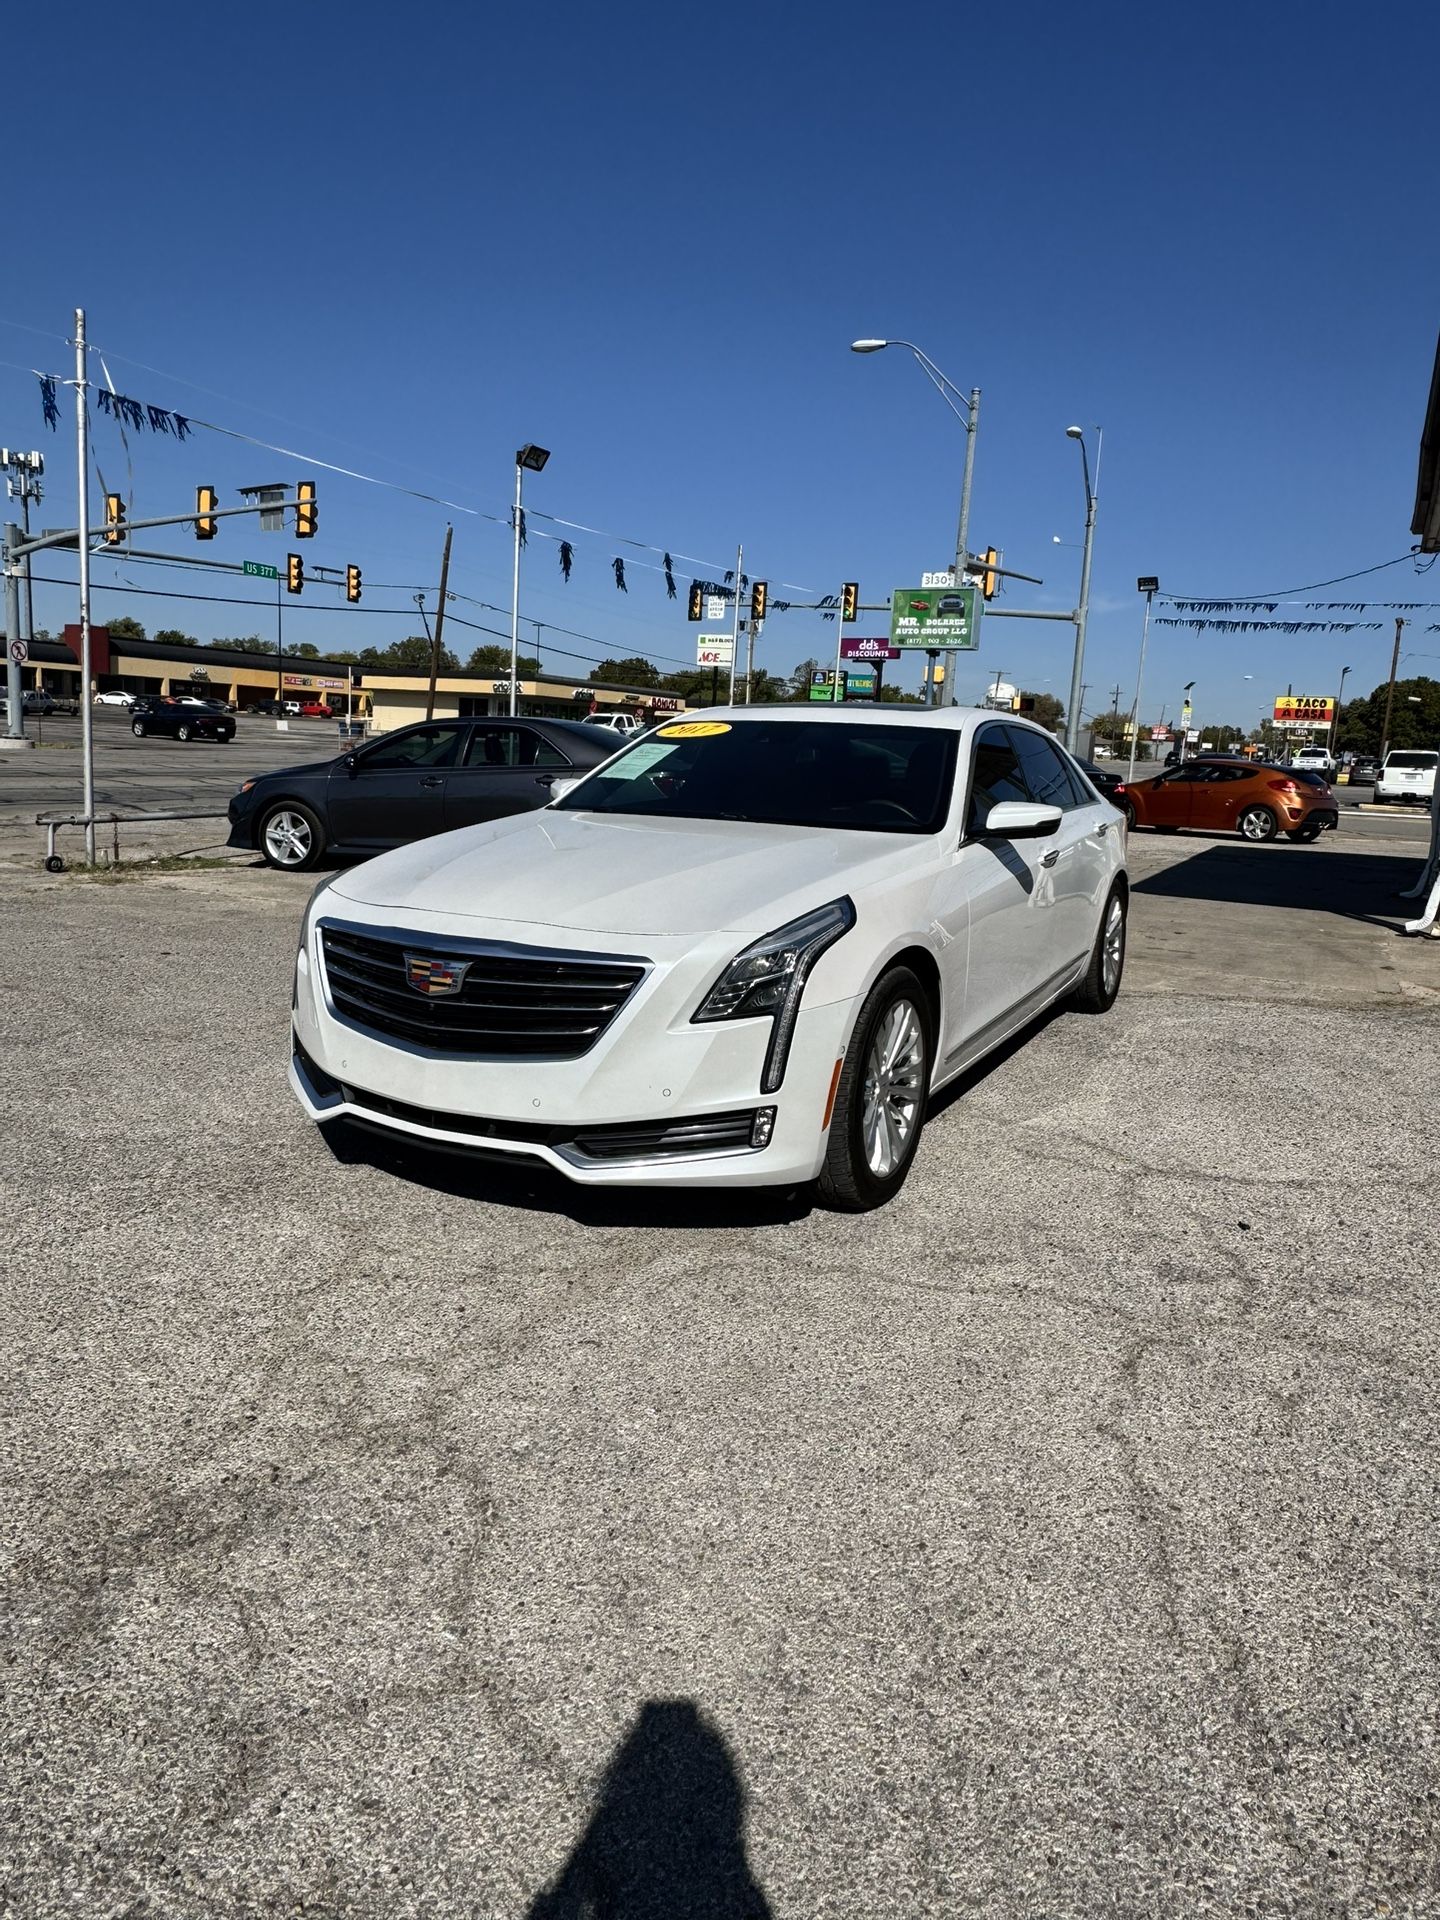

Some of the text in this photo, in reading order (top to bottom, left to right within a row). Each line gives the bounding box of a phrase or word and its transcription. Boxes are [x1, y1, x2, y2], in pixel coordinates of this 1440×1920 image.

[246, 563, 274, 577] US 377
[924, 575, 948, 585] 3130
[898, 617, 920, 626] MR.
[859, 639, 879, 650] dd's
[698, 651, 721, 663] ACE
[1296, 698, 1328, 709] TACO
[1295, 708, 1326, 719] CASA
[666, 724, 723, 736] 2017
